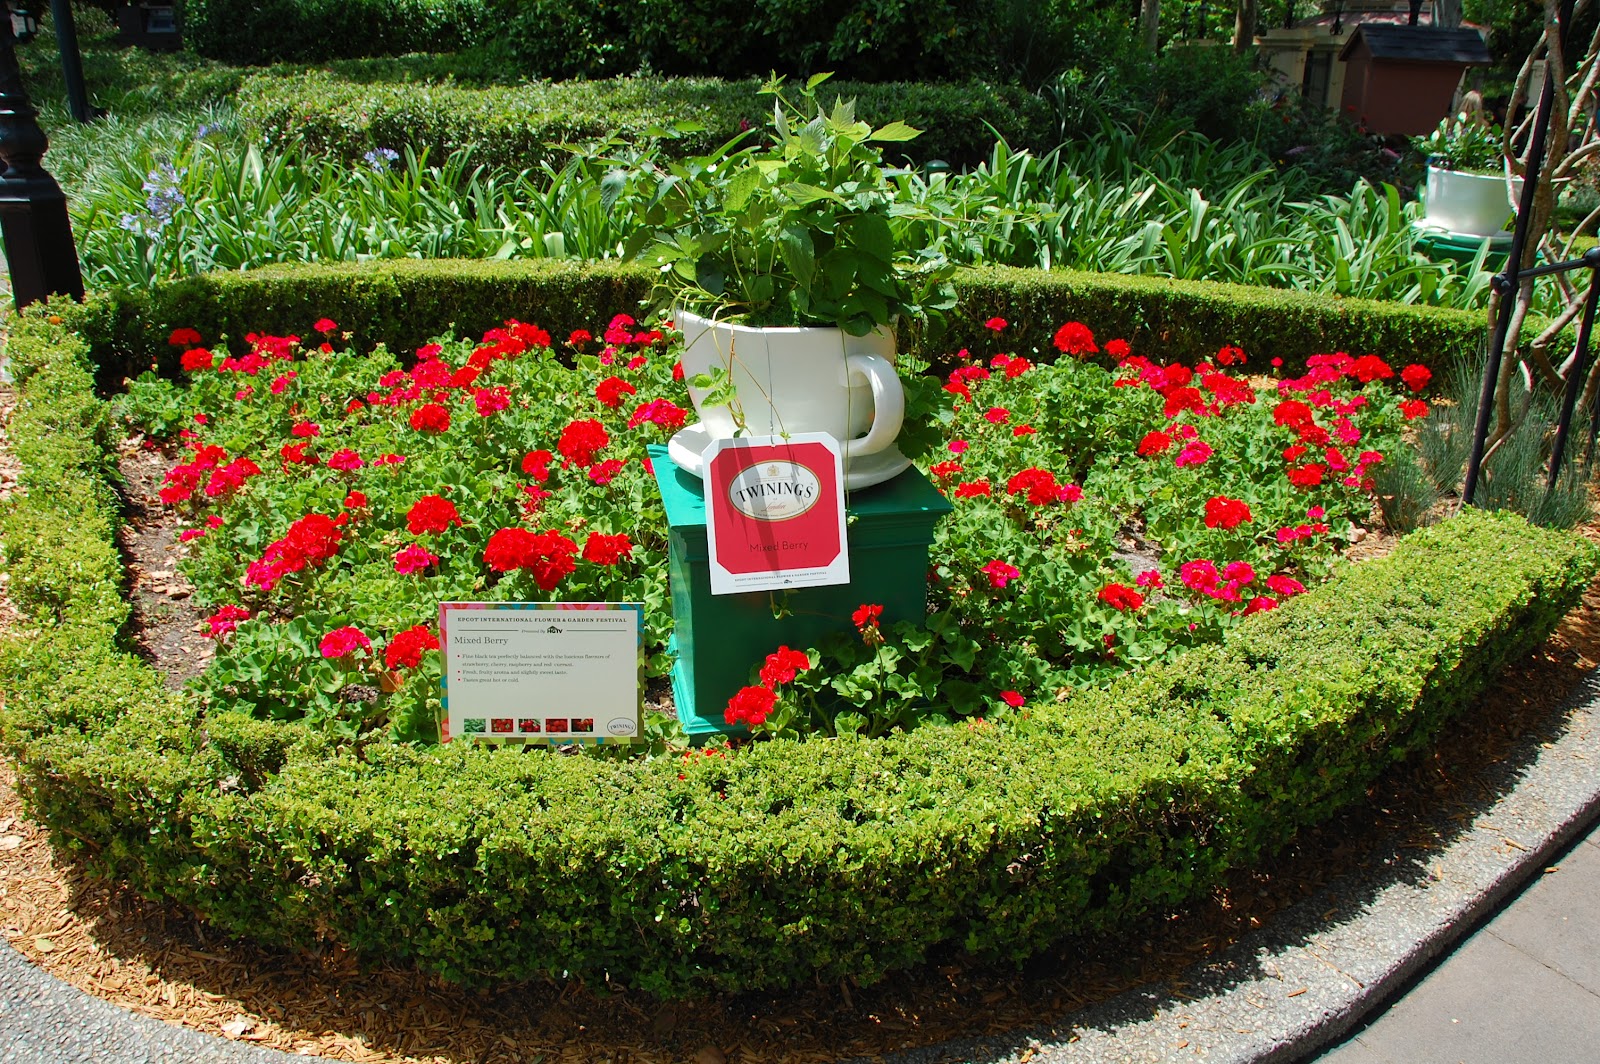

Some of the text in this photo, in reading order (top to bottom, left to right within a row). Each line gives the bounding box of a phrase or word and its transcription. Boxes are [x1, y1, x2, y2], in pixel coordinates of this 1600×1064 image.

[736, 482, 813, 502] TWININGS
[749, 540, 808, 552] Mixed Berry
[484, 637, 508, 645] Berry
